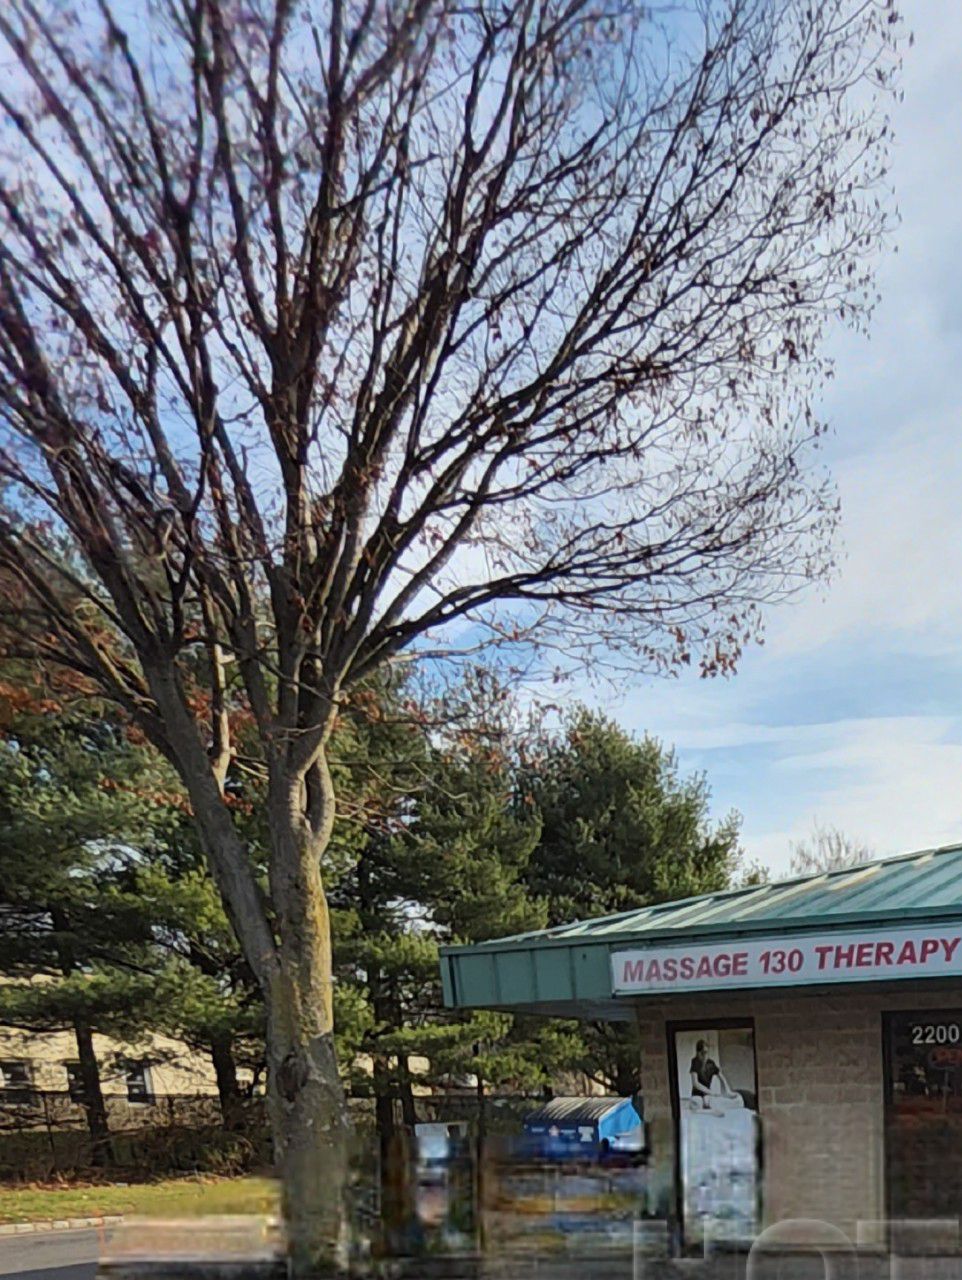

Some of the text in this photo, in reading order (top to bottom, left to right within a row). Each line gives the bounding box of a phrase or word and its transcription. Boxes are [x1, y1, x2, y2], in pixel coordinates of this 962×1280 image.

[623, 952, 749, 983] MASSAGE
[758, 948, 804, 974] 130
[814, 937, 962, 970] THERAPY
[912, 1024, 960, 1044] 2200
